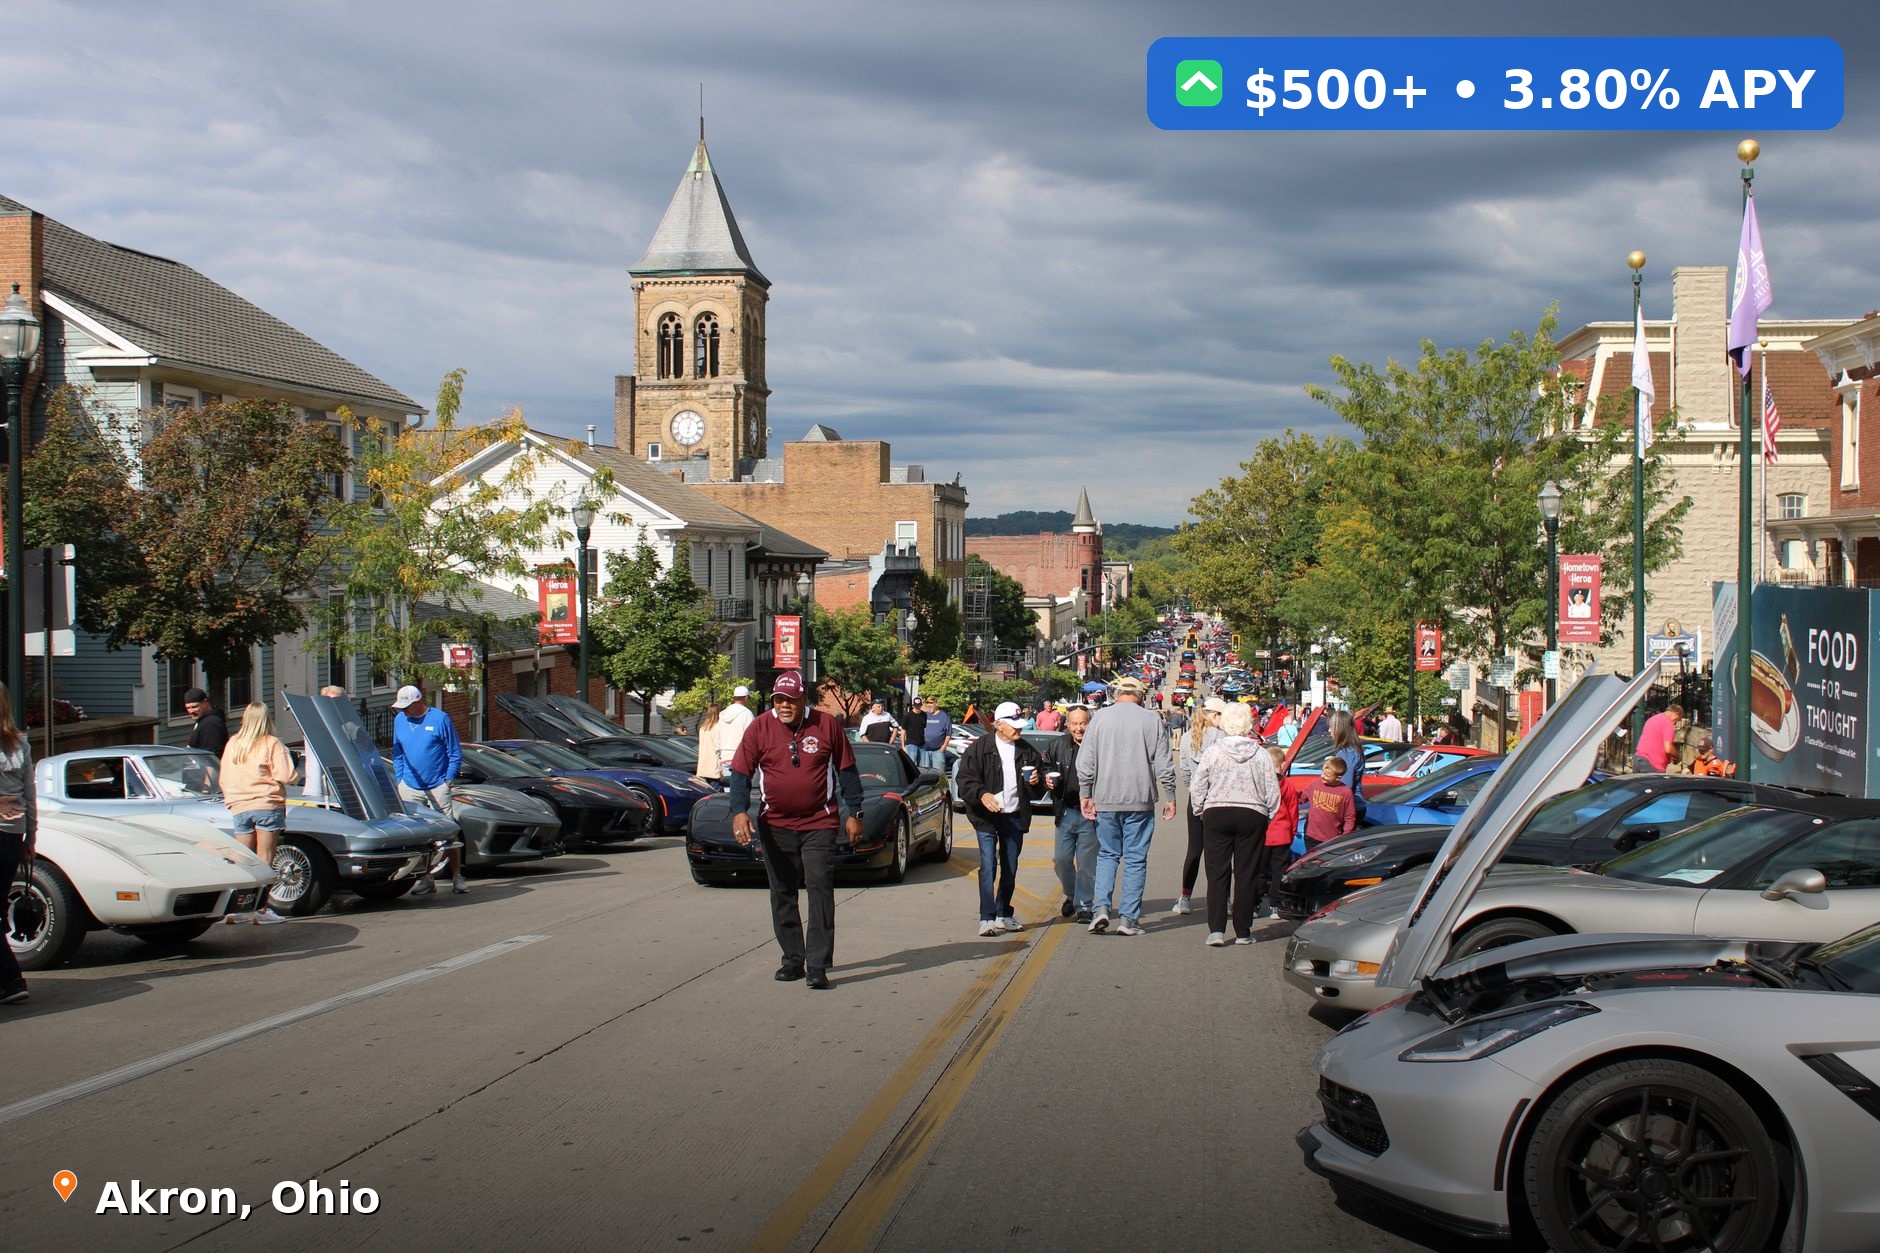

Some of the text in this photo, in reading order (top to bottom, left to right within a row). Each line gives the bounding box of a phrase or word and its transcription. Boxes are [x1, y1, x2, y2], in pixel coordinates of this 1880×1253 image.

[1560, 562, 1599, 574] Hometown
[1808, 628, 1857, 671] FOOD
[1821, 679, 1840, 700] FOR
[1806, 705, 1857, 739] THOUGHT
